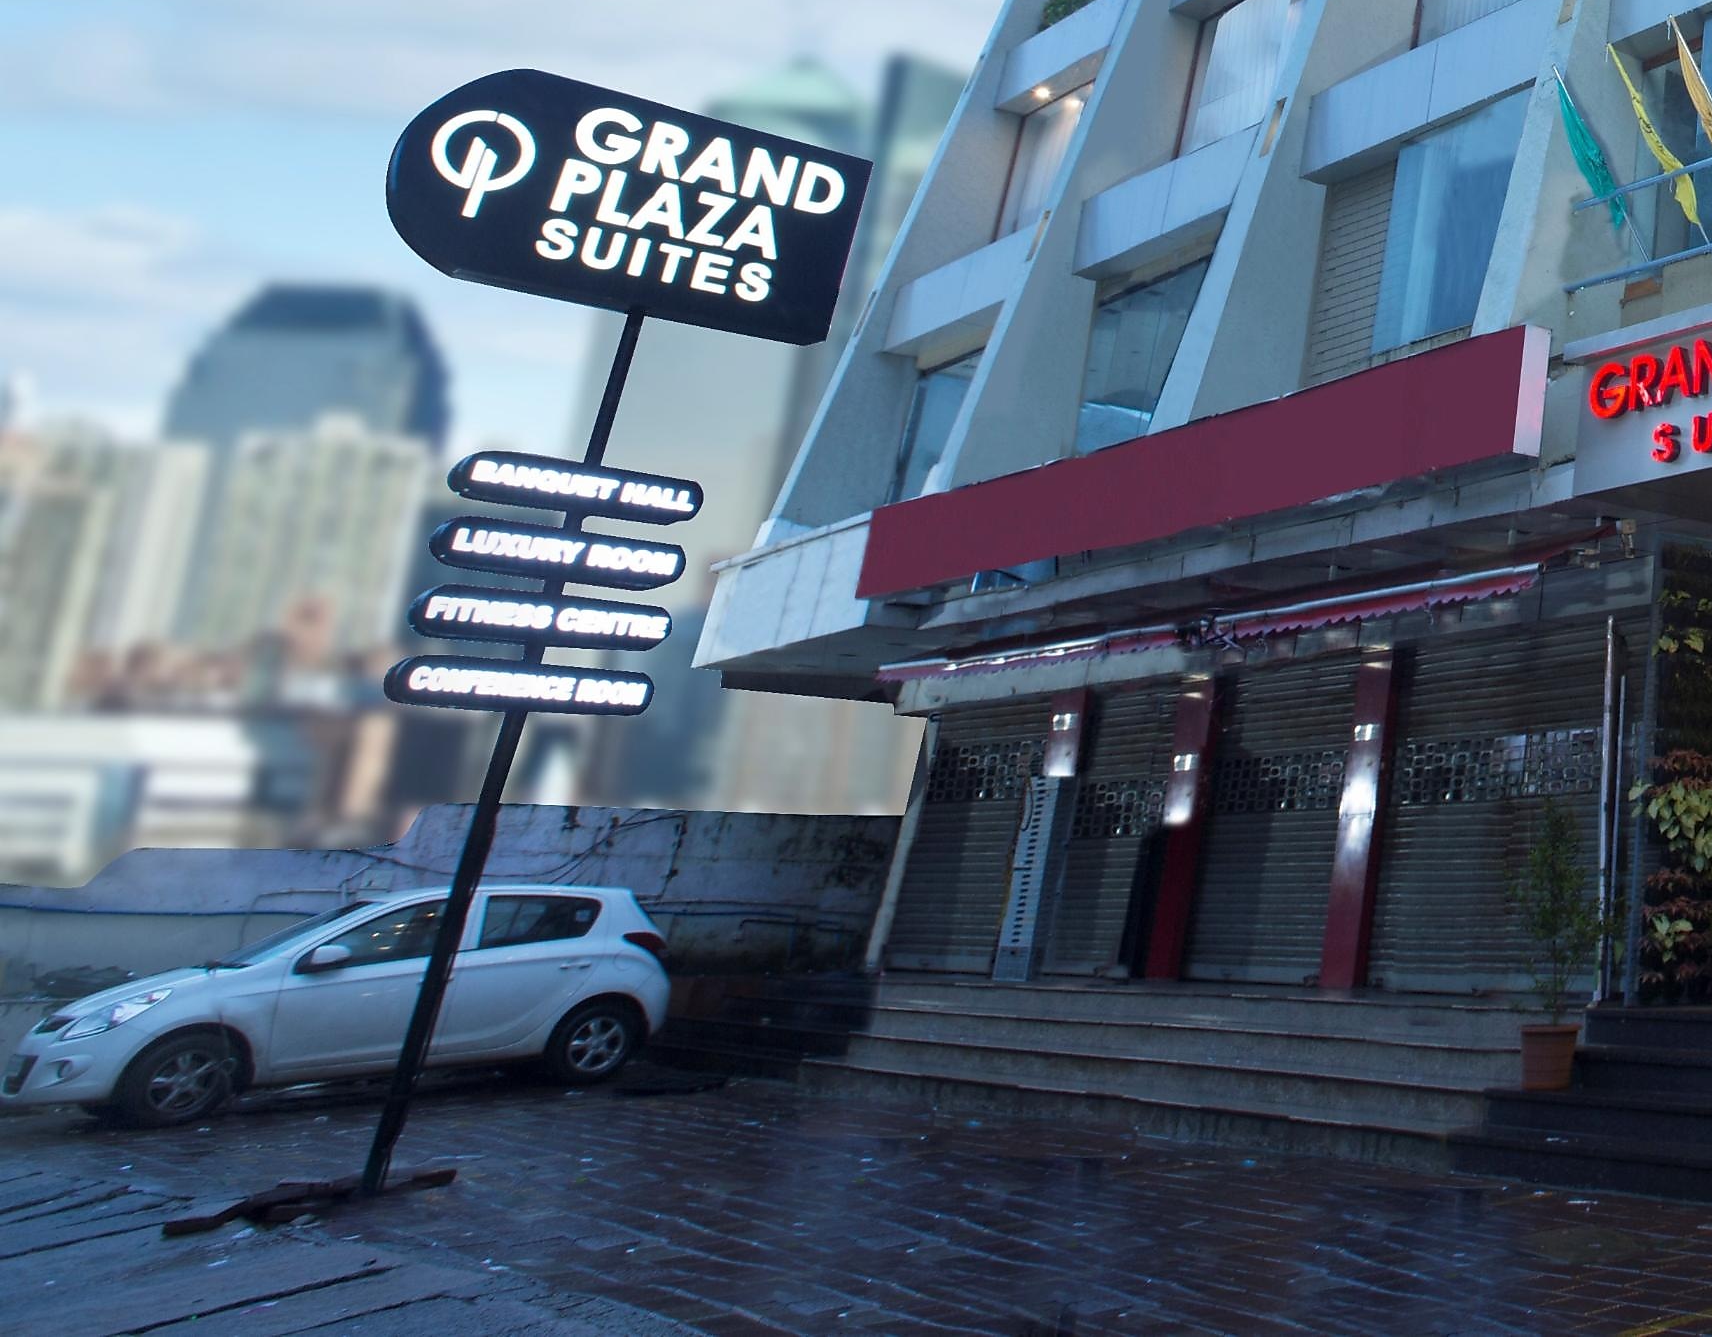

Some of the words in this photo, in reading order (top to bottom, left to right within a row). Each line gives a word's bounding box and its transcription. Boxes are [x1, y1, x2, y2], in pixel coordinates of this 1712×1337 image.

[575, 107, 845, 215] GRAND
[549, 158, 778, 260] PLAZA
[535, 218, 773, 303] SUITES
[470, 459, 620, 502] BANQUET
[619, 481, 694, 512] HALL
[451, 526, 587, 566] LUXURY
[586, 543, 679, 576] ROOM
[424, 596, 554, 630] FITNESS
[556, 607, 670, 638] CENTRE
[408, 665, 577, 702] CONFERENCE
[574, 678, 648, 706] ROOM
